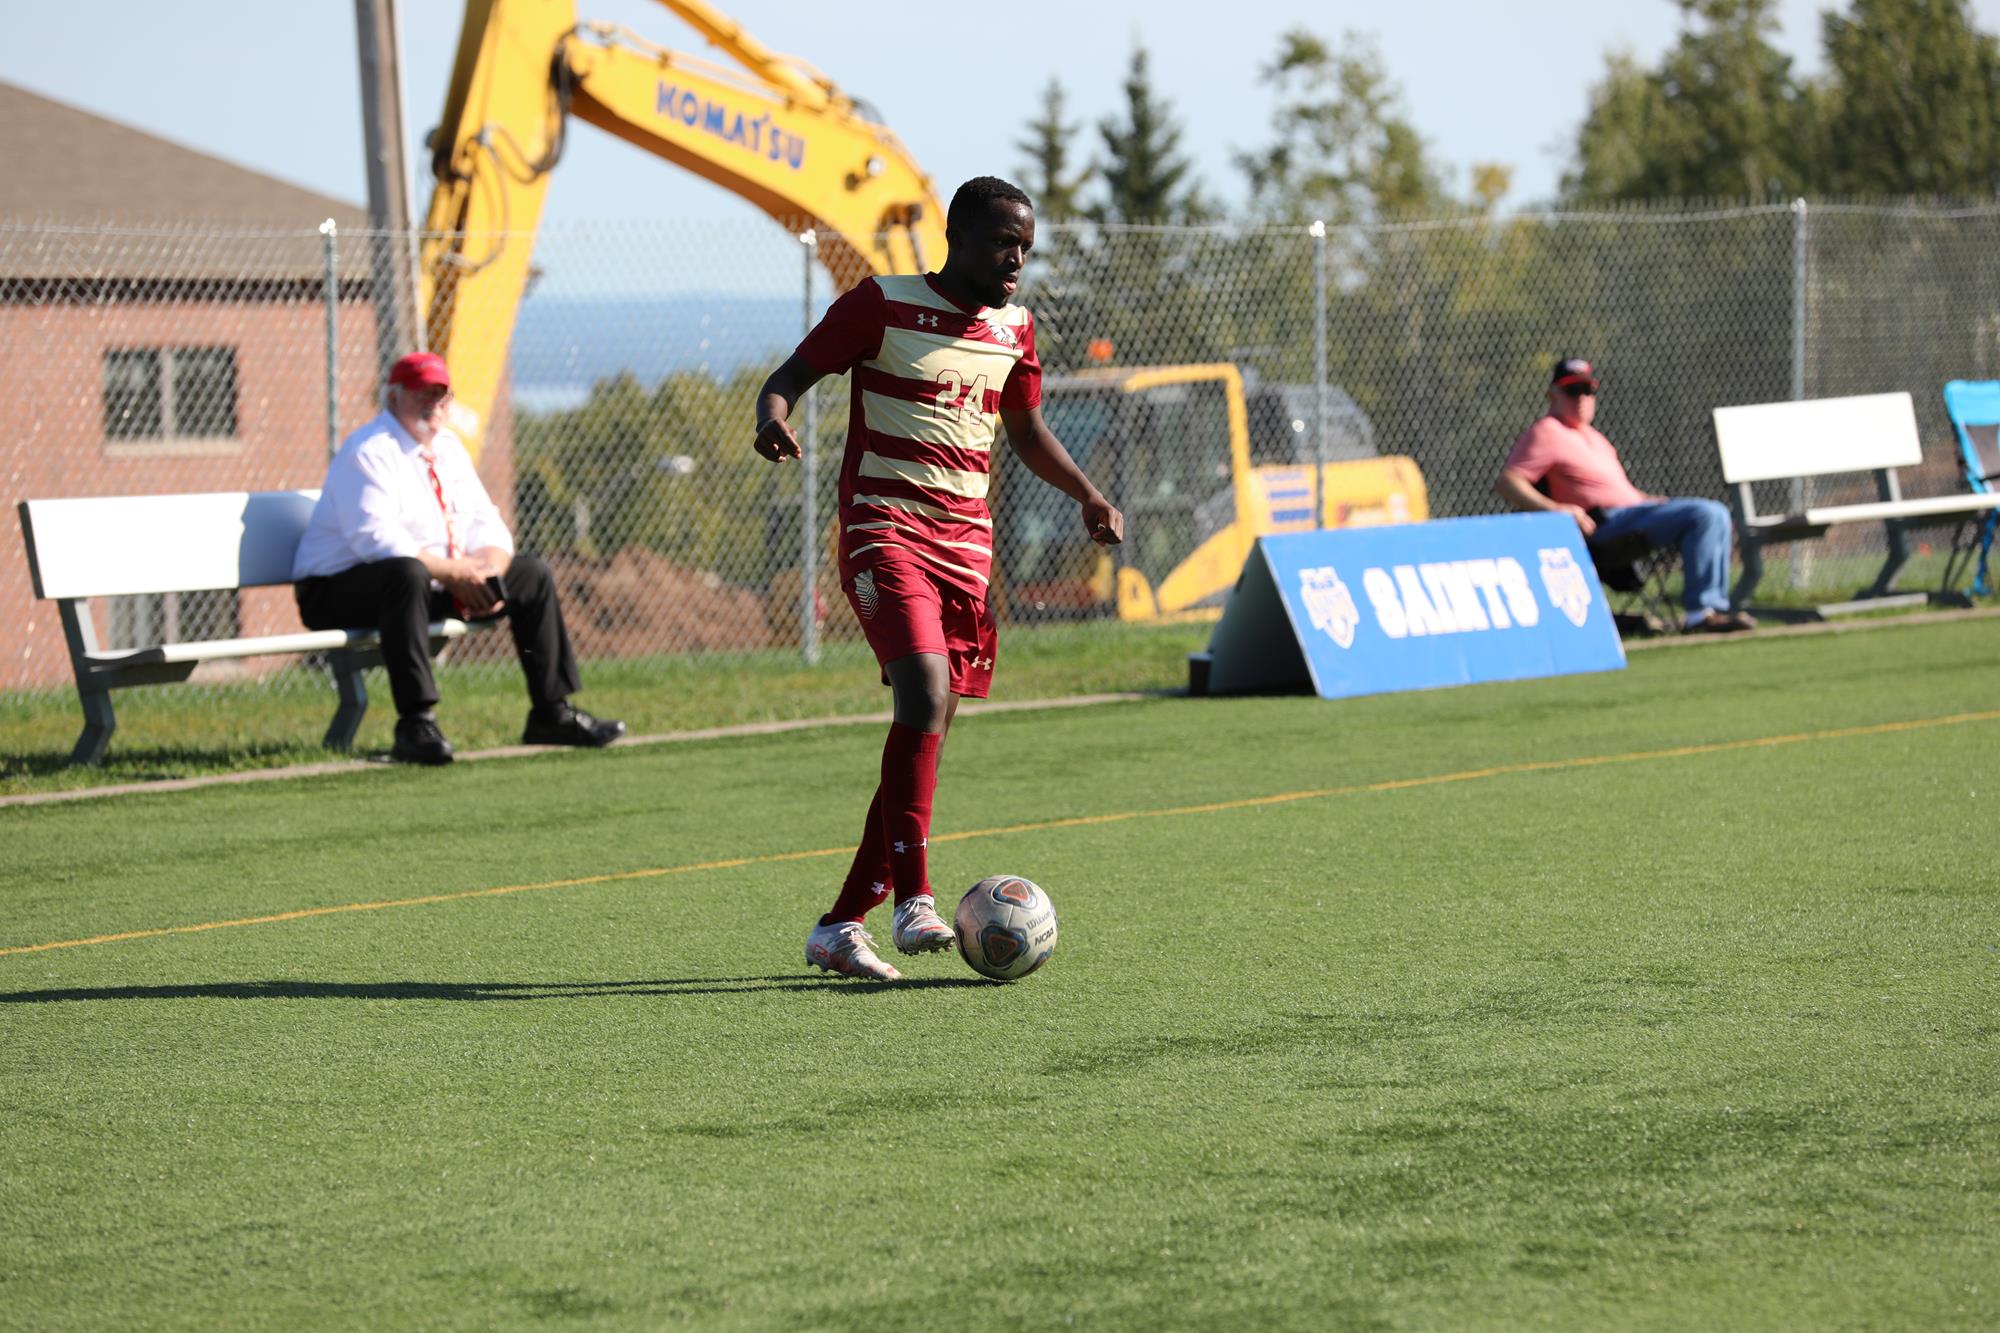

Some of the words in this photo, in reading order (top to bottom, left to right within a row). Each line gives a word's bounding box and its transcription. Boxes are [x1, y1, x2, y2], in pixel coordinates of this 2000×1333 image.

[656, 81, 805, 170] KOMATSU
[933, 368, 988, 426] 24
[1363, 557, 1539, 638] SAINTS
